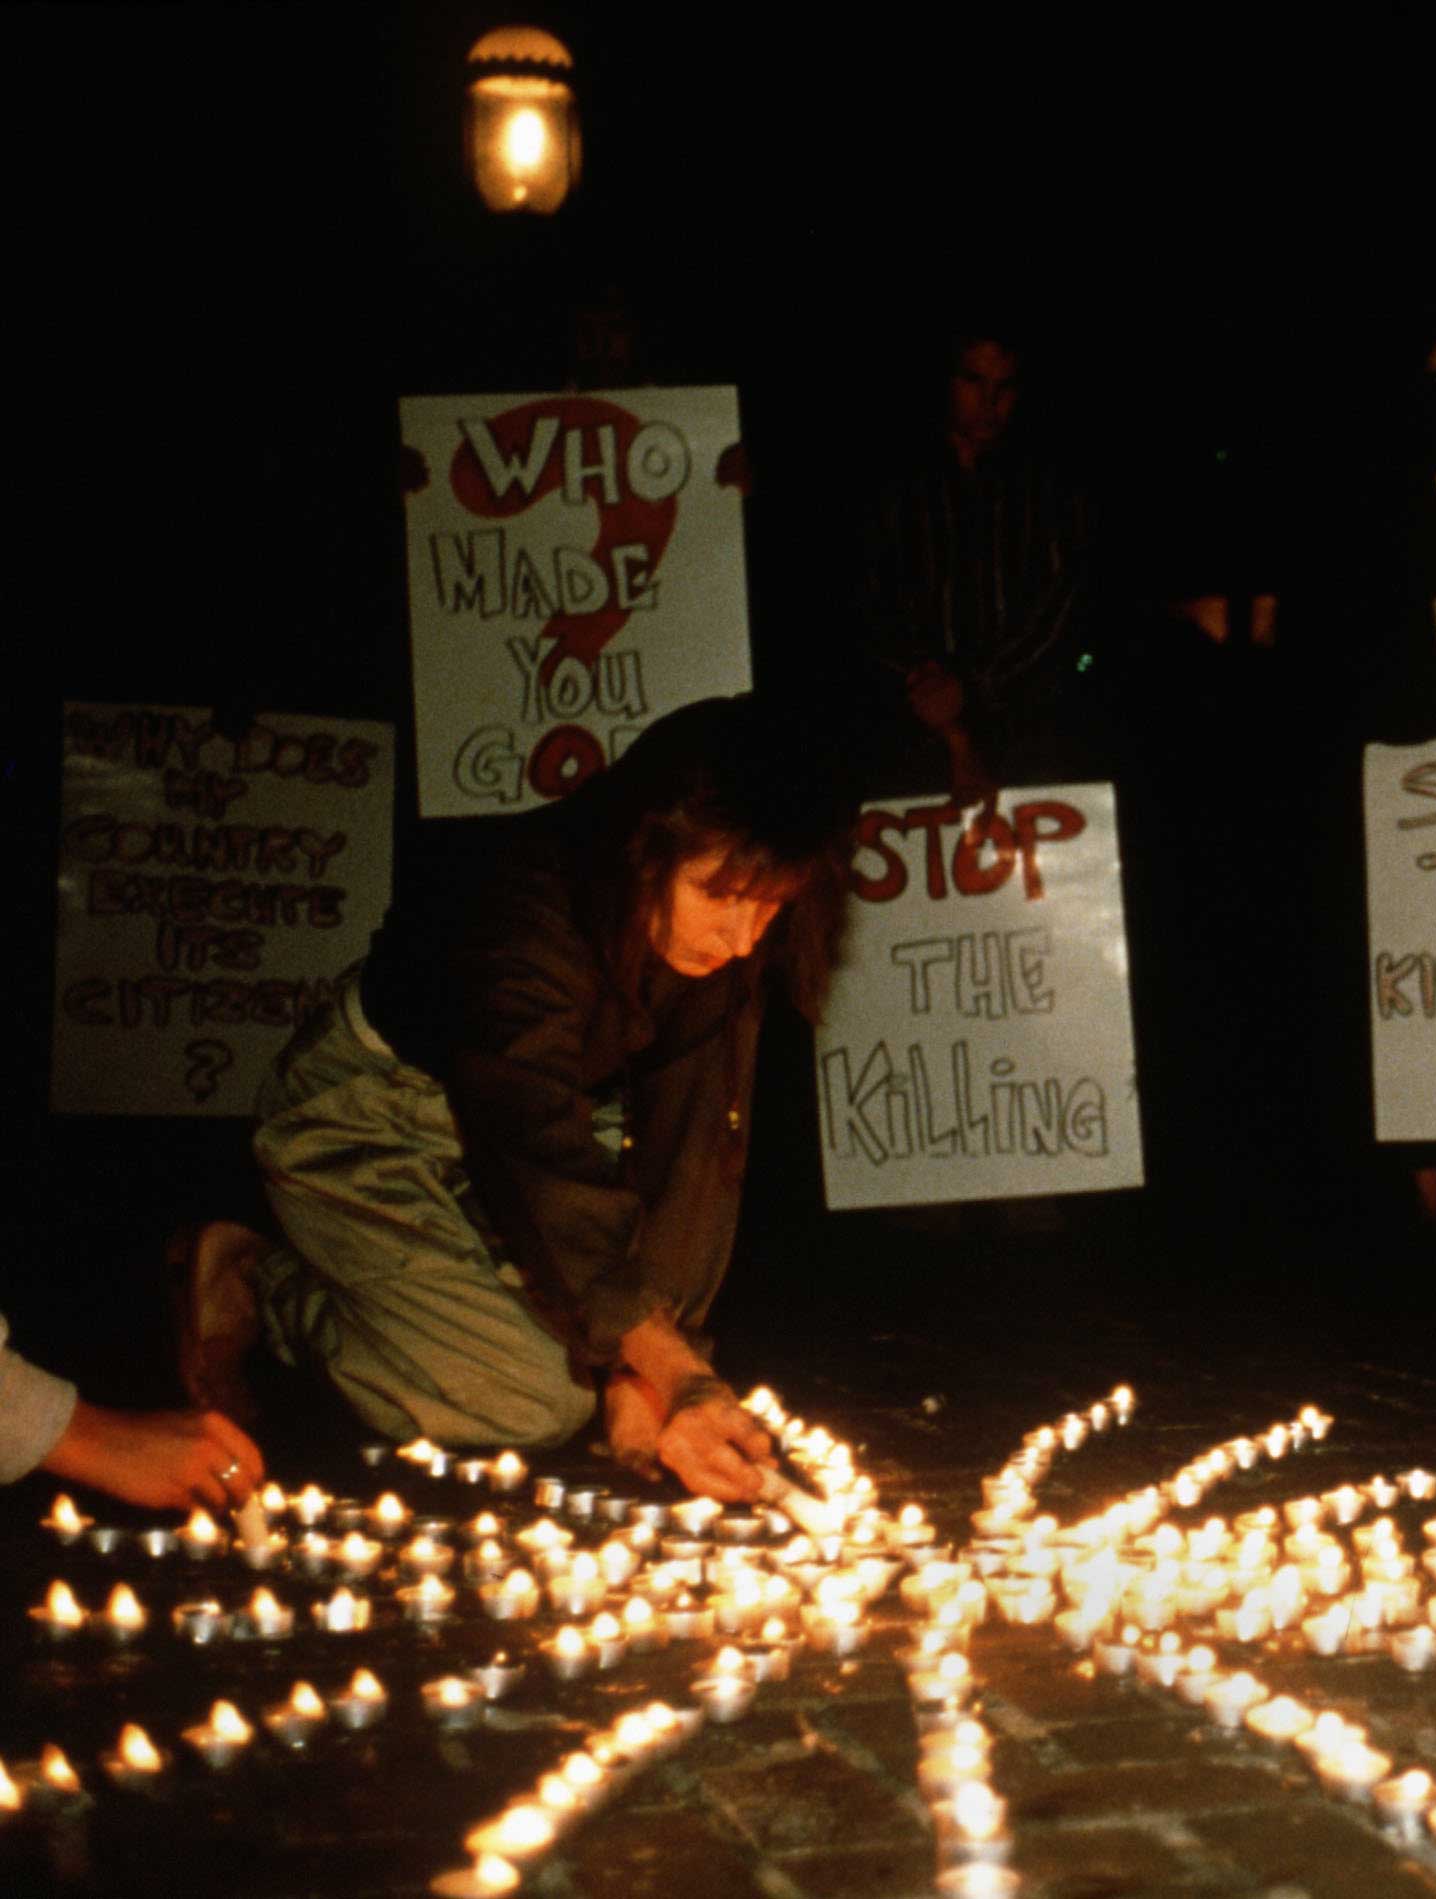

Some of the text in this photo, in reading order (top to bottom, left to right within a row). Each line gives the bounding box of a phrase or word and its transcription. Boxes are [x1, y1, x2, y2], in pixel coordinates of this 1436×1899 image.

[457, 415, 692, 505] WHO
[430, 527, 660, 620] MADE
[508, 635, 648, 725] YOU
[66, 709, 378, 788] WHY DOES
[452, 724, 641, 804] GO
[63, 813, 347, 880] COUNTRY
[850, 800, 1088, 903] STOP
[88, 869, 347, 929] EXECUTE
[155, 918, 265, 971] ITS
[891, 926, 1057, 1021] THE
